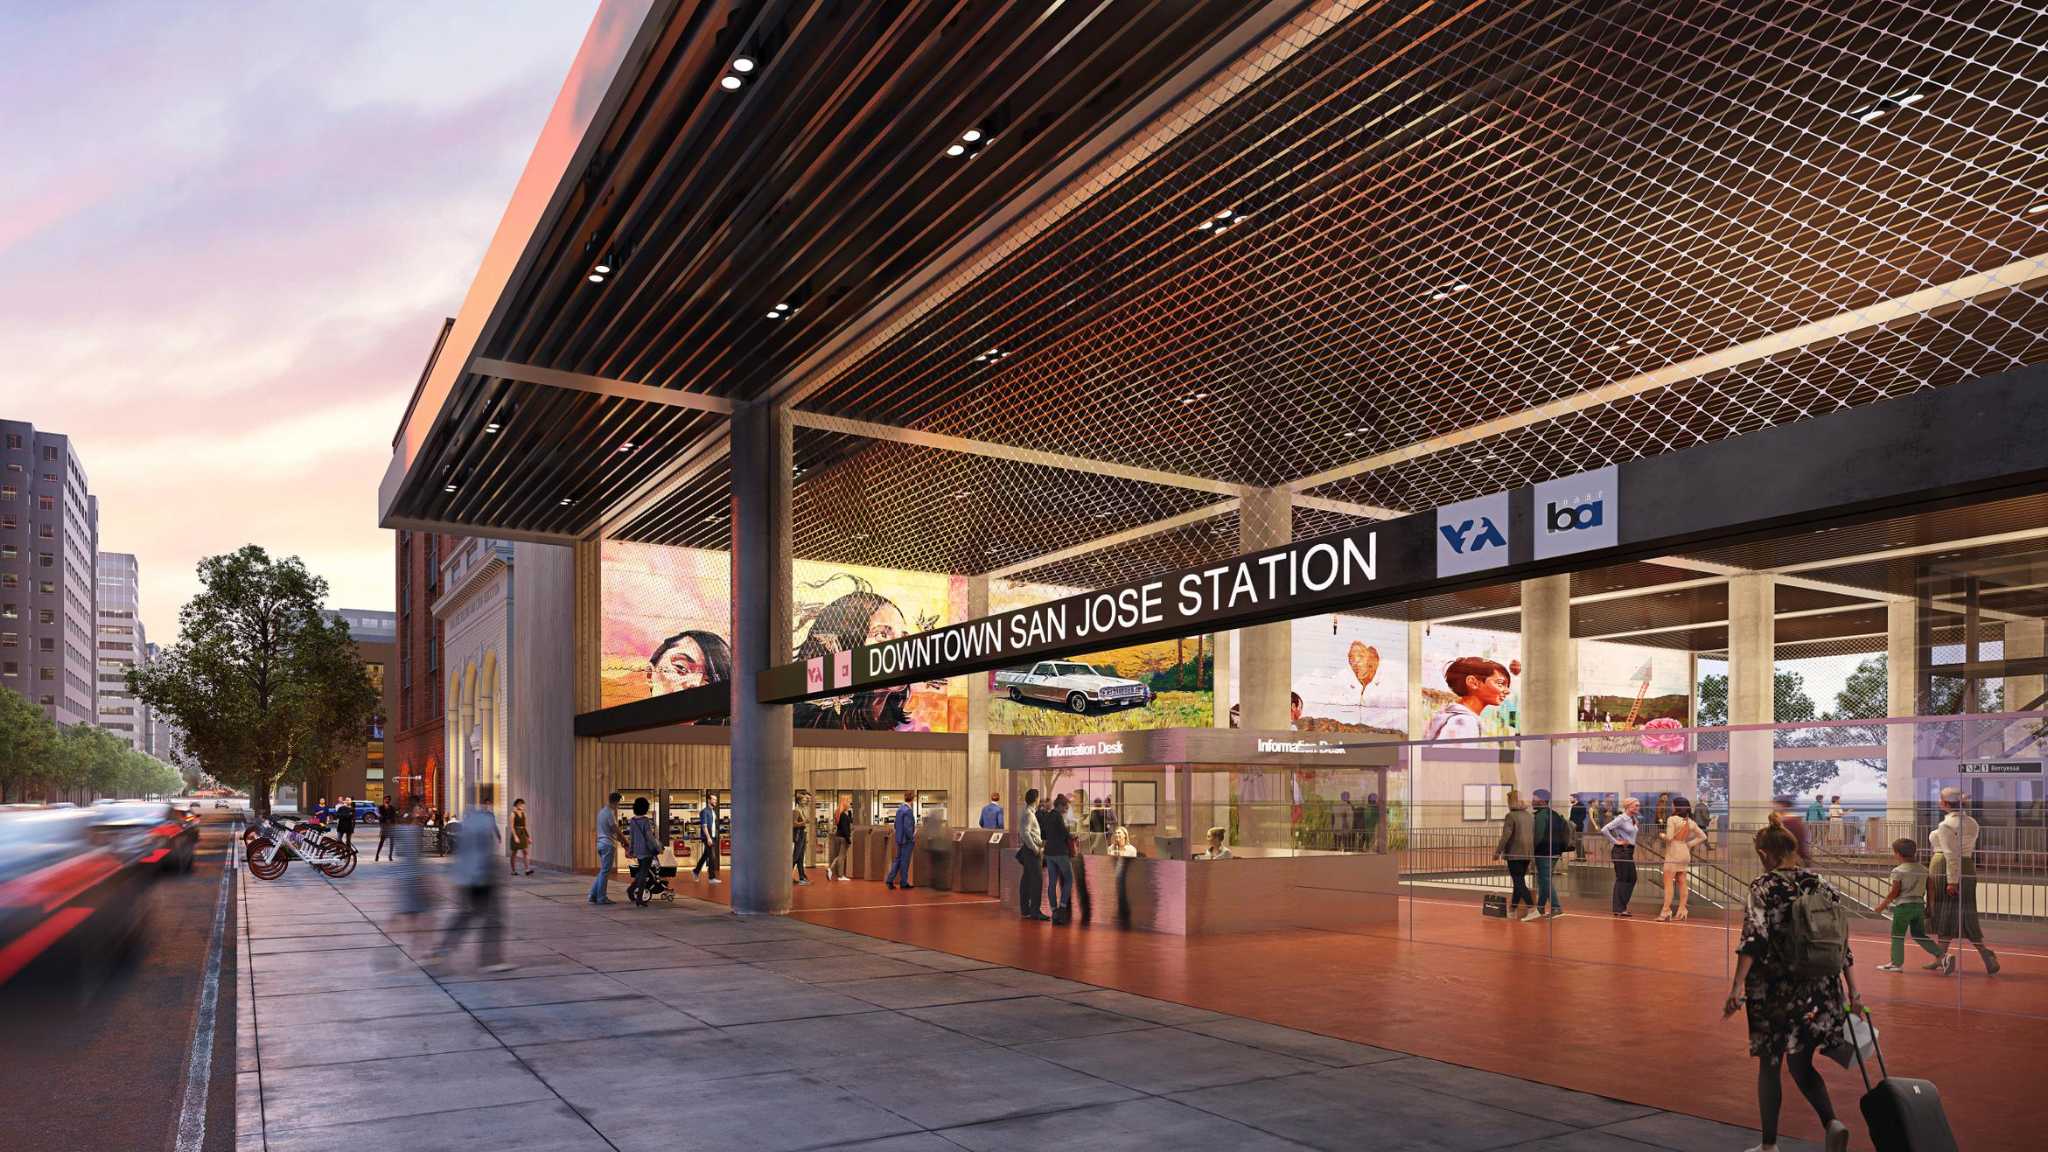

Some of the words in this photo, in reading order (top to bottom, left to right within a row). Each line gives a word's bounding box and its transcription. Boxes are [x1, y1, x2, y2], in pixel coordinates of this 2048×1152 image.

[869, 619, 1002, 677] DOWNTOWN
[1010, 603, 1067, 649] SAN
[1076, 581, 1164, 638] JOSE
[1178, 531, 1377, 616] STATION
[1046, 743, 1097, 758] Information
[1098, 741, 1124, 754] Desk
[1257, 738, 1318, 753] Information
